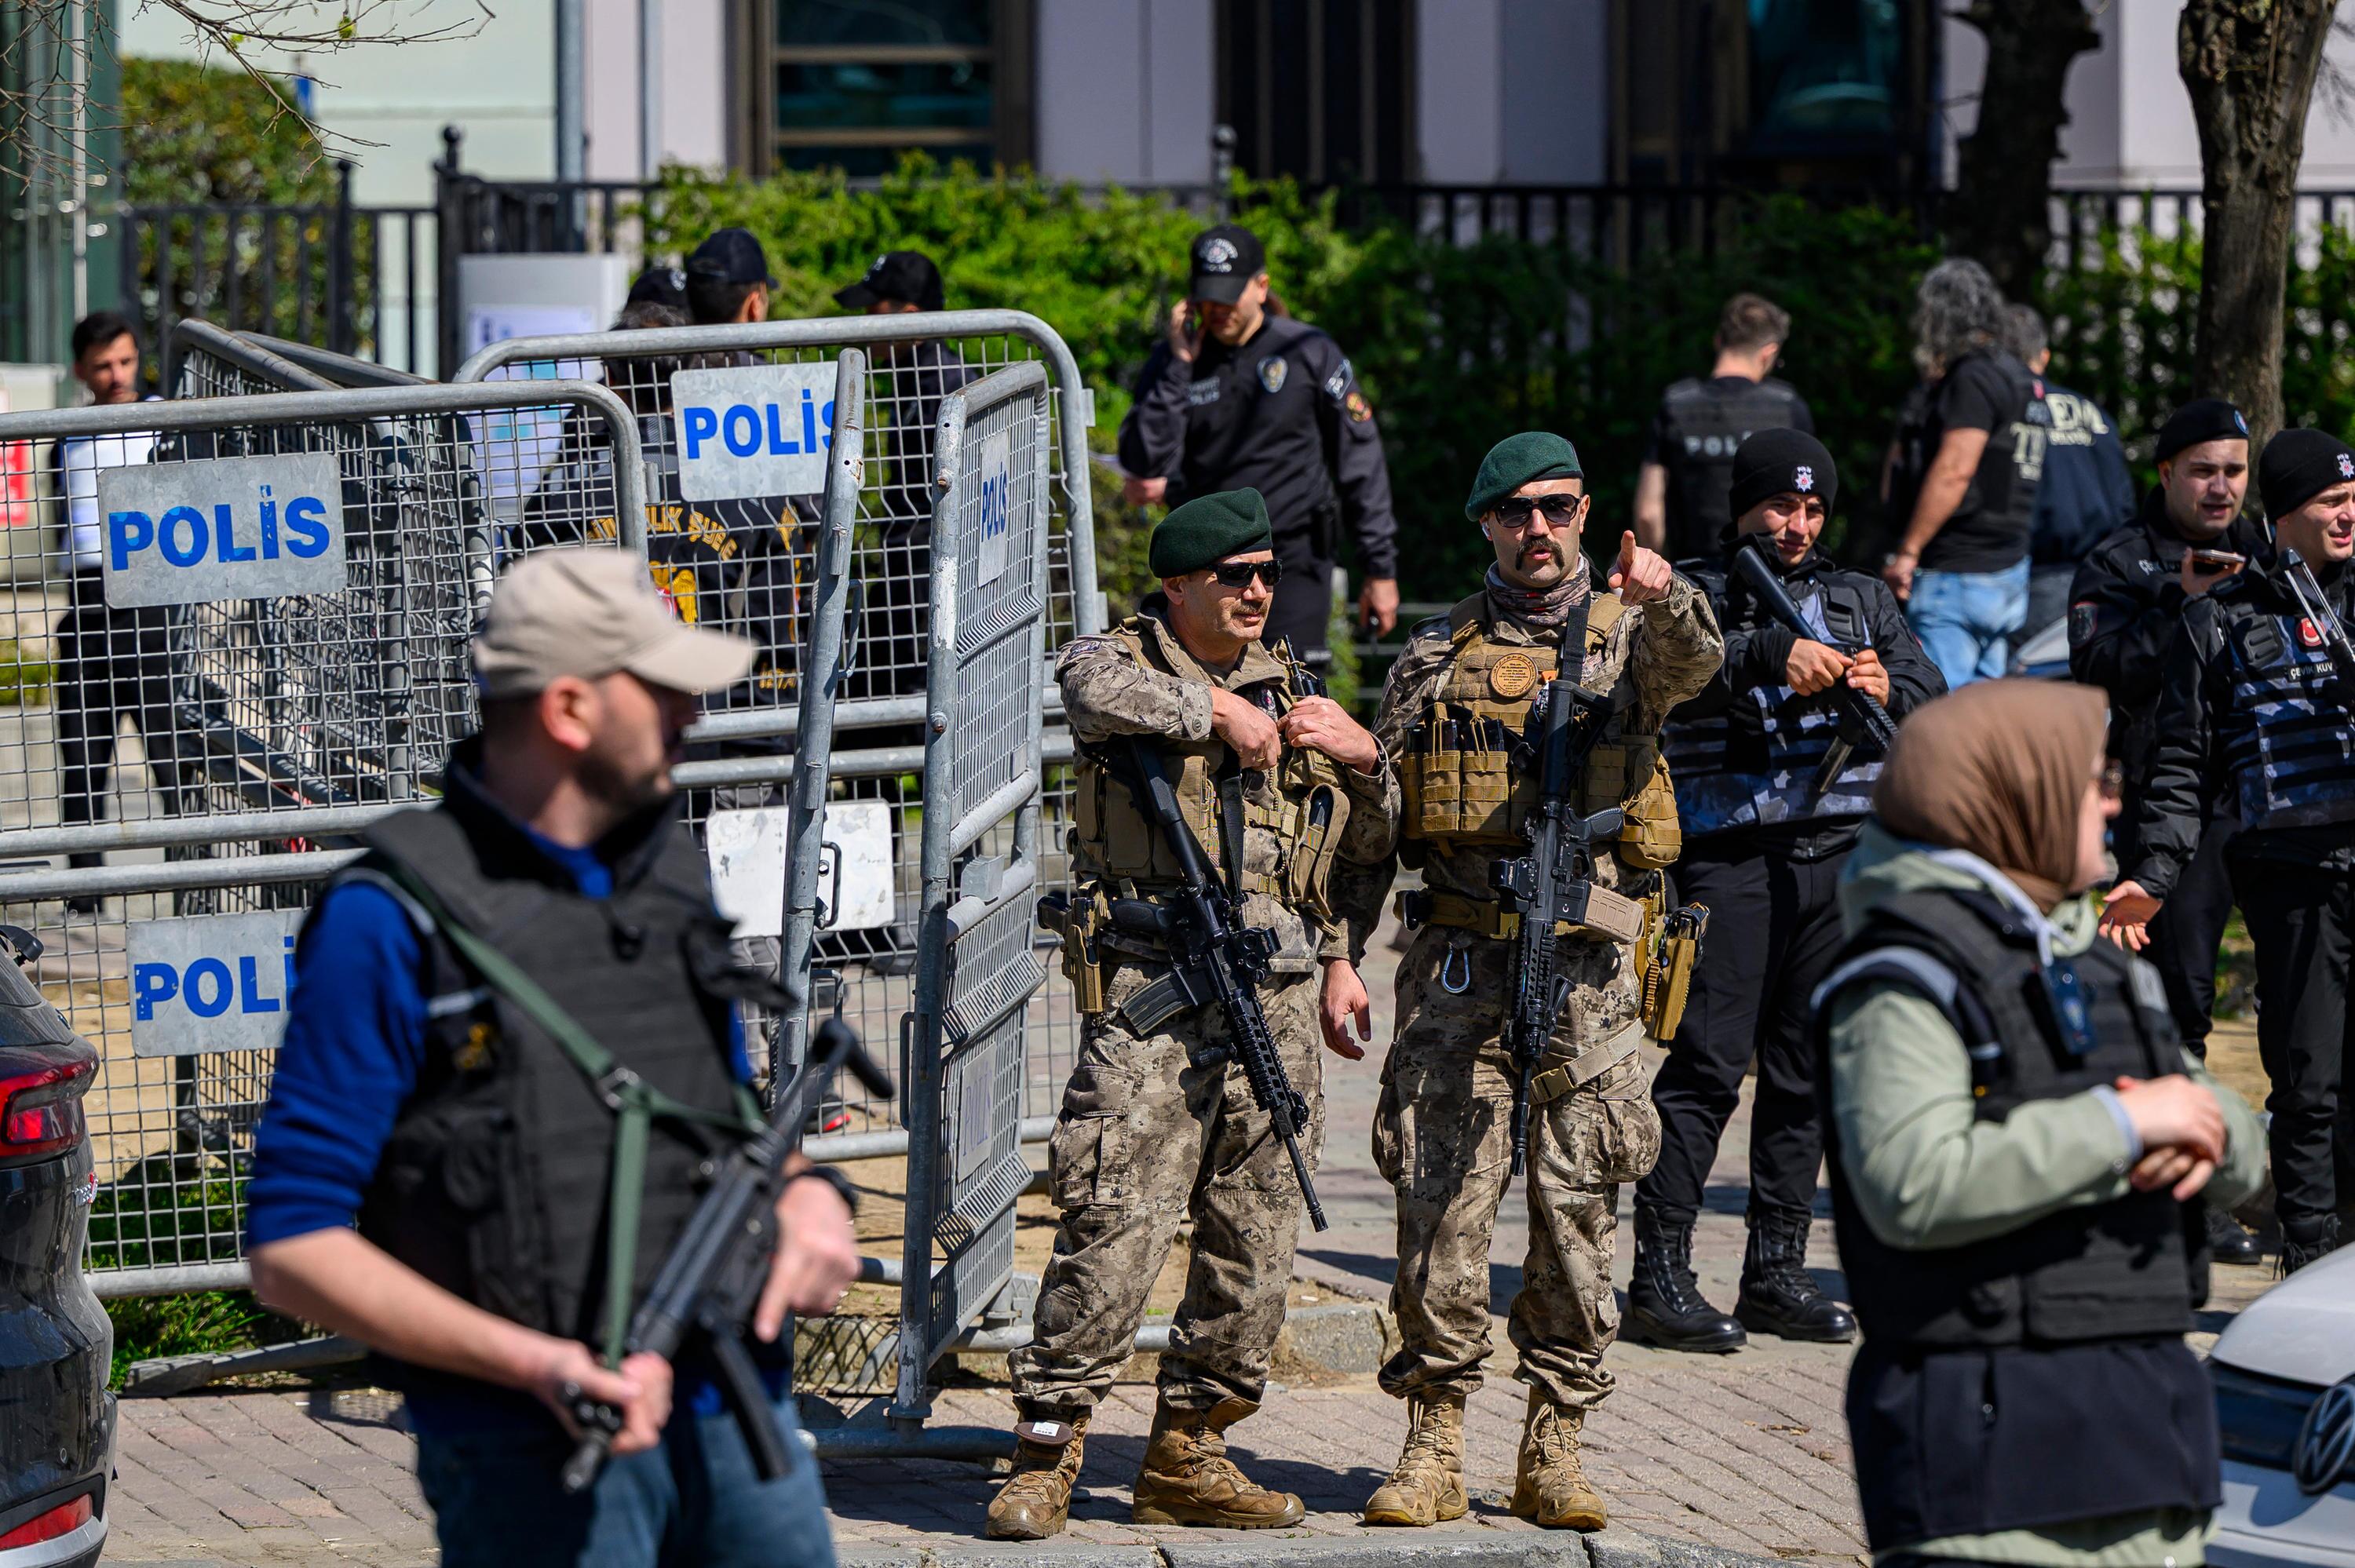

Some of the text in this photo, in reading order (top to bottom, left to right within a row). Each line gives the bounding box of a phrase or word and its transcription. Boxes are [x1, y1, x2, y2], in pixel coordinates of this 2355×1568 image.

[108, 484, 330, 571] POLİS
[981, 461, 1007, 542] POLİS
[2316, 662, 2334, 673] KUV
[133, 935, 300, 1021] POLİ
